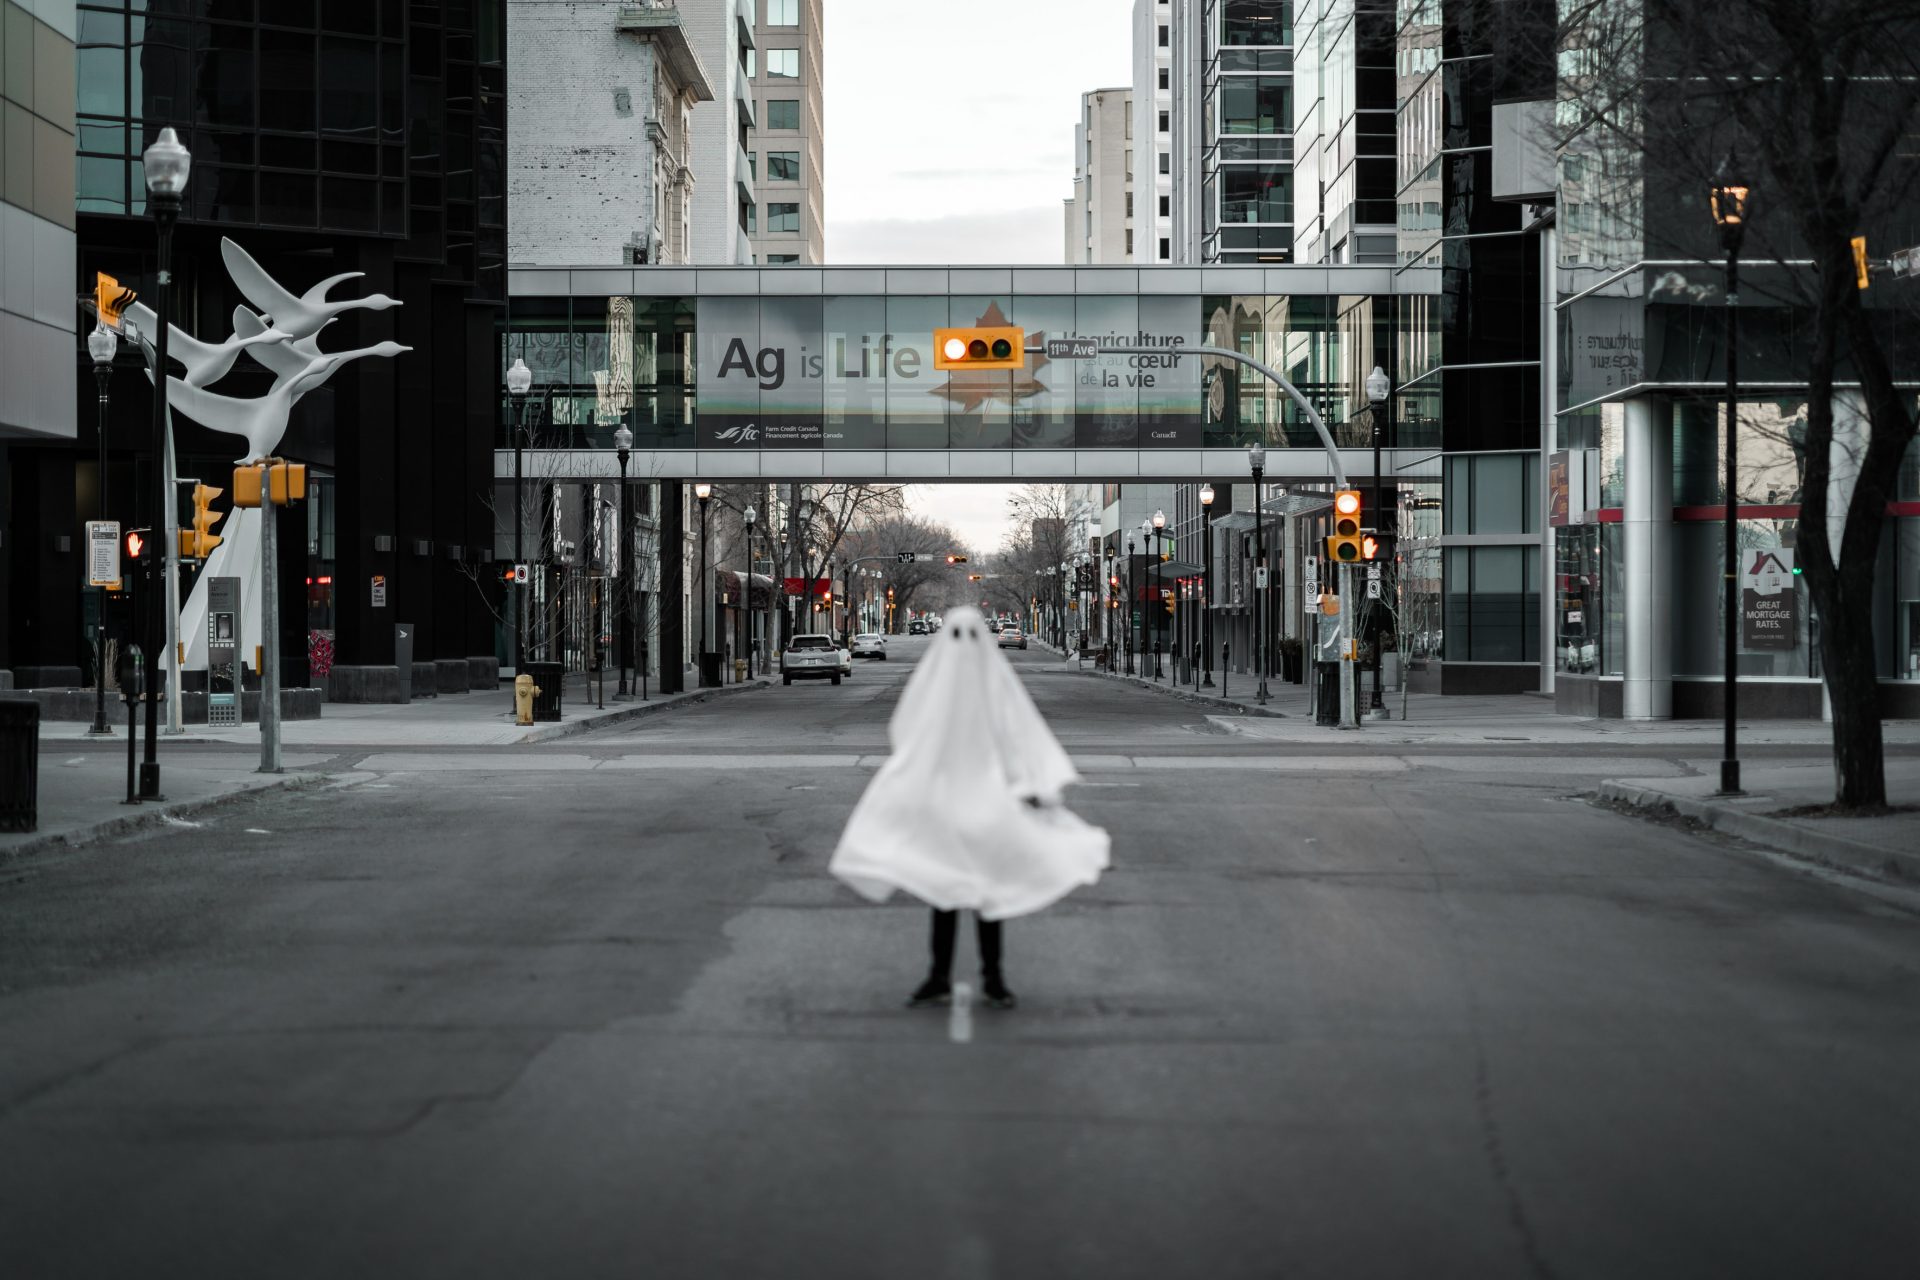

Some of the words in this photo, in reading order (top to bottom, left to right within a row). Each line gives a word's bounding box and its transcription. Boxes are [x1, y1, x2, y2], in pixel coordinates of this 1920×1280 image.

[1050, 343, 1069, 356] 11th
[1072, 343, 1096, 356] Ave
[717, 337, 785, 390] Ag
[801, 346, 823, 378] is
[836, 334, 921, 379] Life
[1107, 357, 1124, 367] au
[1128, 355, 1182, 369] cœur
[1080, 373, 1097, 386] de
[1102, 369, 1119, 388] la
[1126, 370, 1156, 388] vie
[734, 423, 760, 444] fcc
[801, 432, 822, 440] agricole
[1151, 431, 1177, 439] Canada
[1756, 600, 1781, 609] GREAT
[1746, 610, 1791, 619] MORTGAGE
[1755, 620, 1782, 629] RATES.
